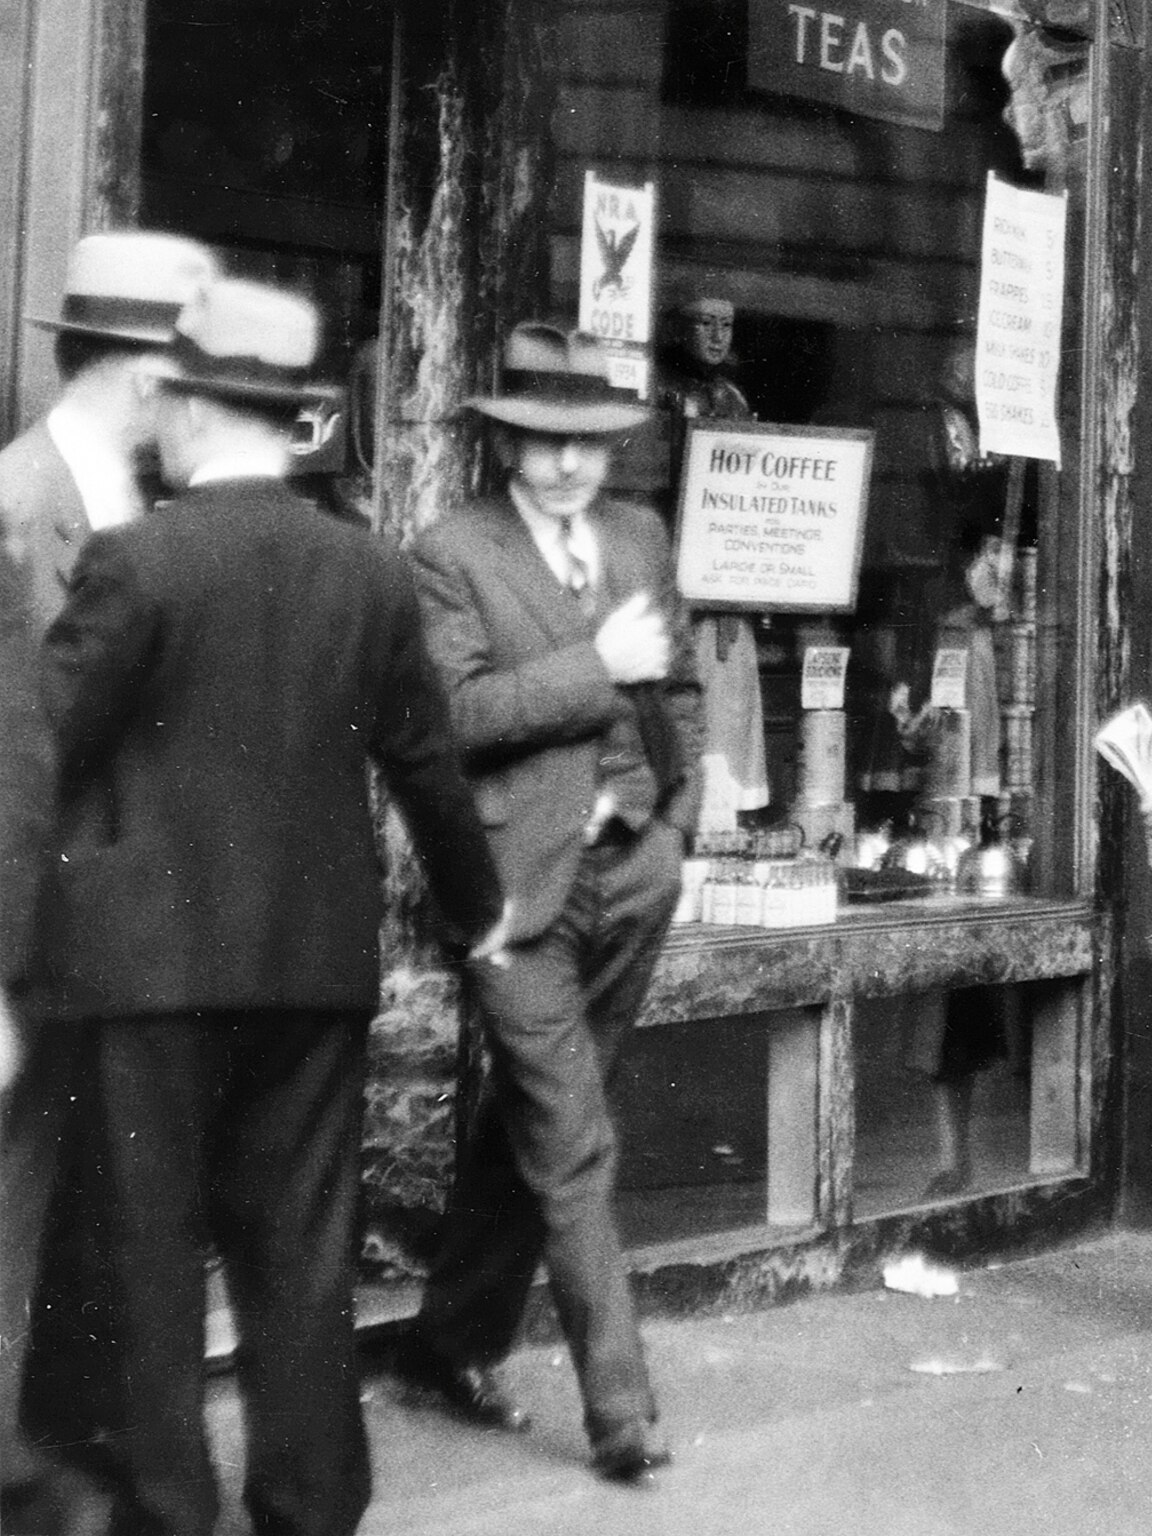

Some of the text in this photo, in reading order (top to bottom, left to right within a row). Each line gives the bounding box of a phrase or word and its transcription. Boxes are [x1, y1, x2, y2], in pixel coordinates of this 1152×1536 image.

[788, 3, 908, 86] TEAS
[596, 193, 637, 220] NRA
[590, 308, 635, 340] CODE
[709, 448, 838, 482] HOT COFFEE
[701, 487, 838, 520] INSULATED TANKS
[723, 538, 807, 556] CONVENTIONS
